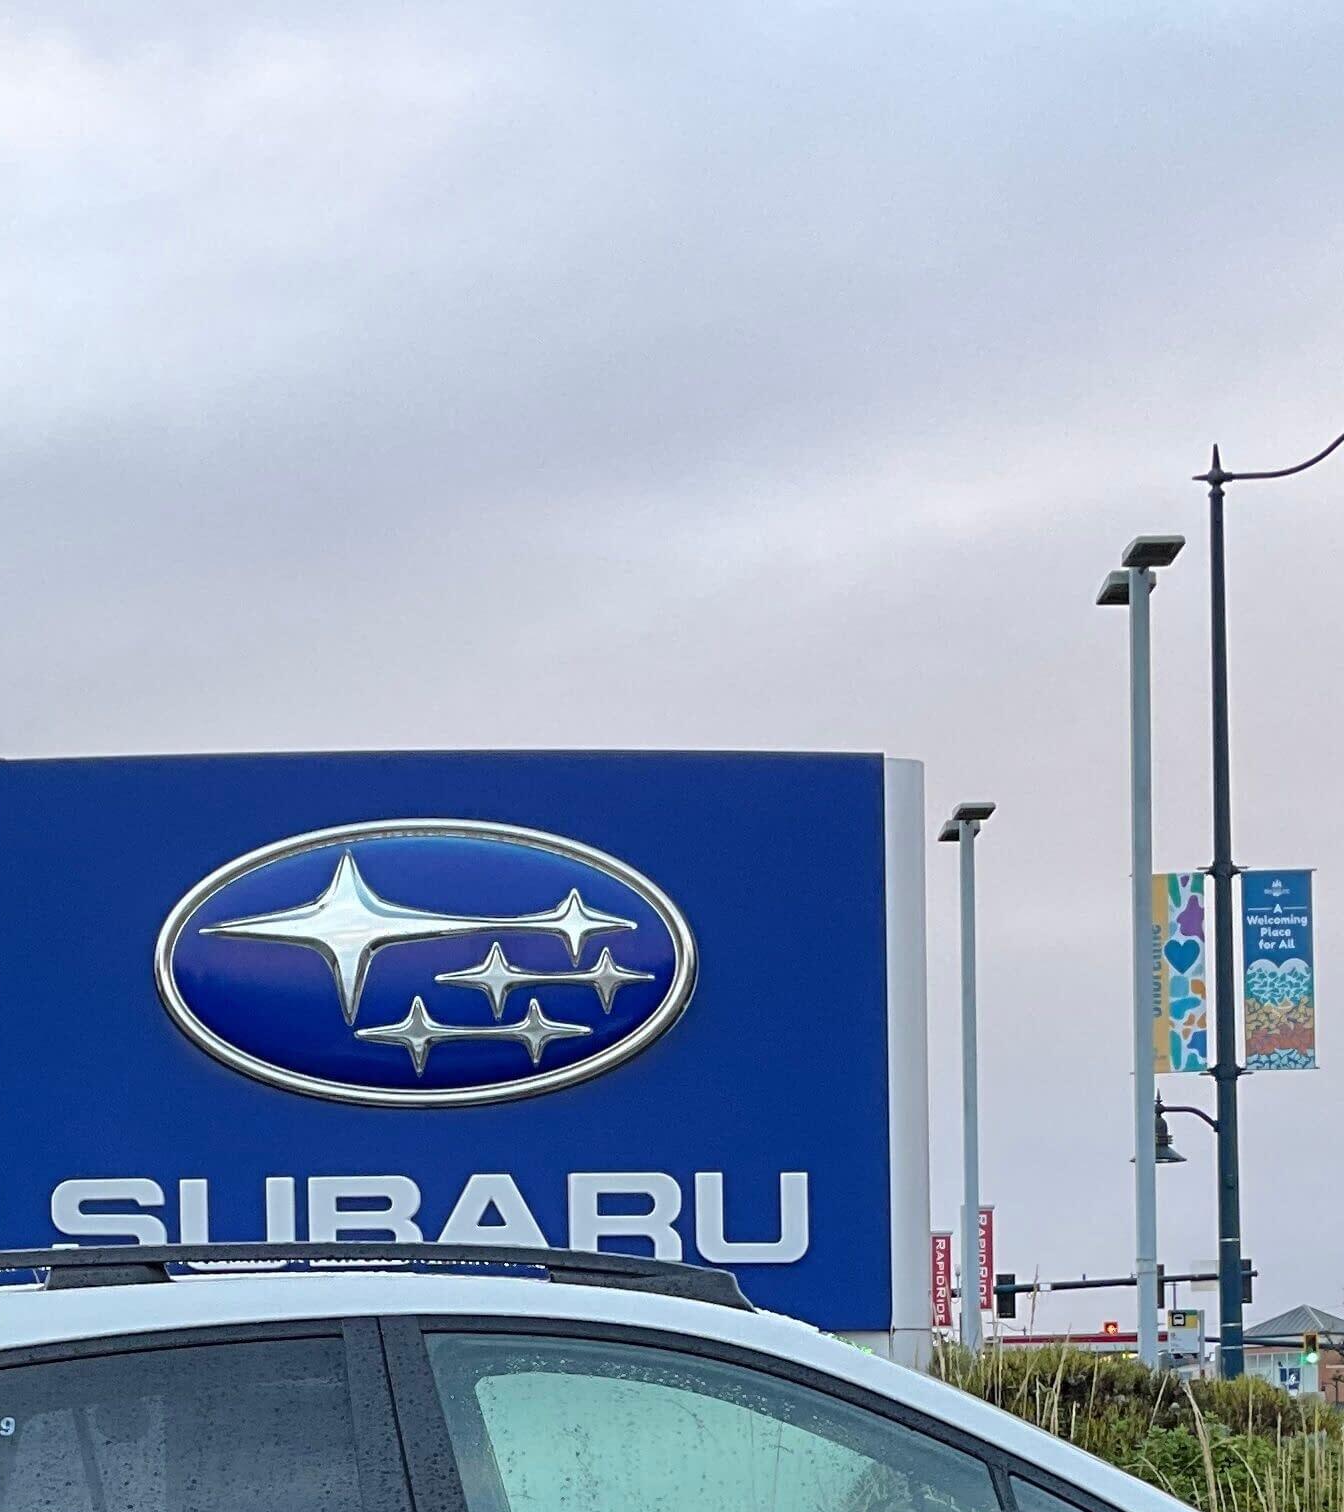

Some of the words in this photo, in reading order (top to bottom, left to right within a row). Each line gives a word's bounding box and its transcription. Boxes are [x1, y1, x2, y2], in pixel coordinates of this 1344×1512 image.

[1273, 903, 1283, 914] A
[1247, 914, 1308, 927] Welcoming
[1260, 927, 1291, 937] Place
[1258, 939, 1276, 950] for
[1278, 939, 1296, 949] All
[51, 1171, 809, 1270] SUBARU
[935, 1239, 946, 1324] RAPIDRIDE
[0, 1416, 16, 1437] 9
